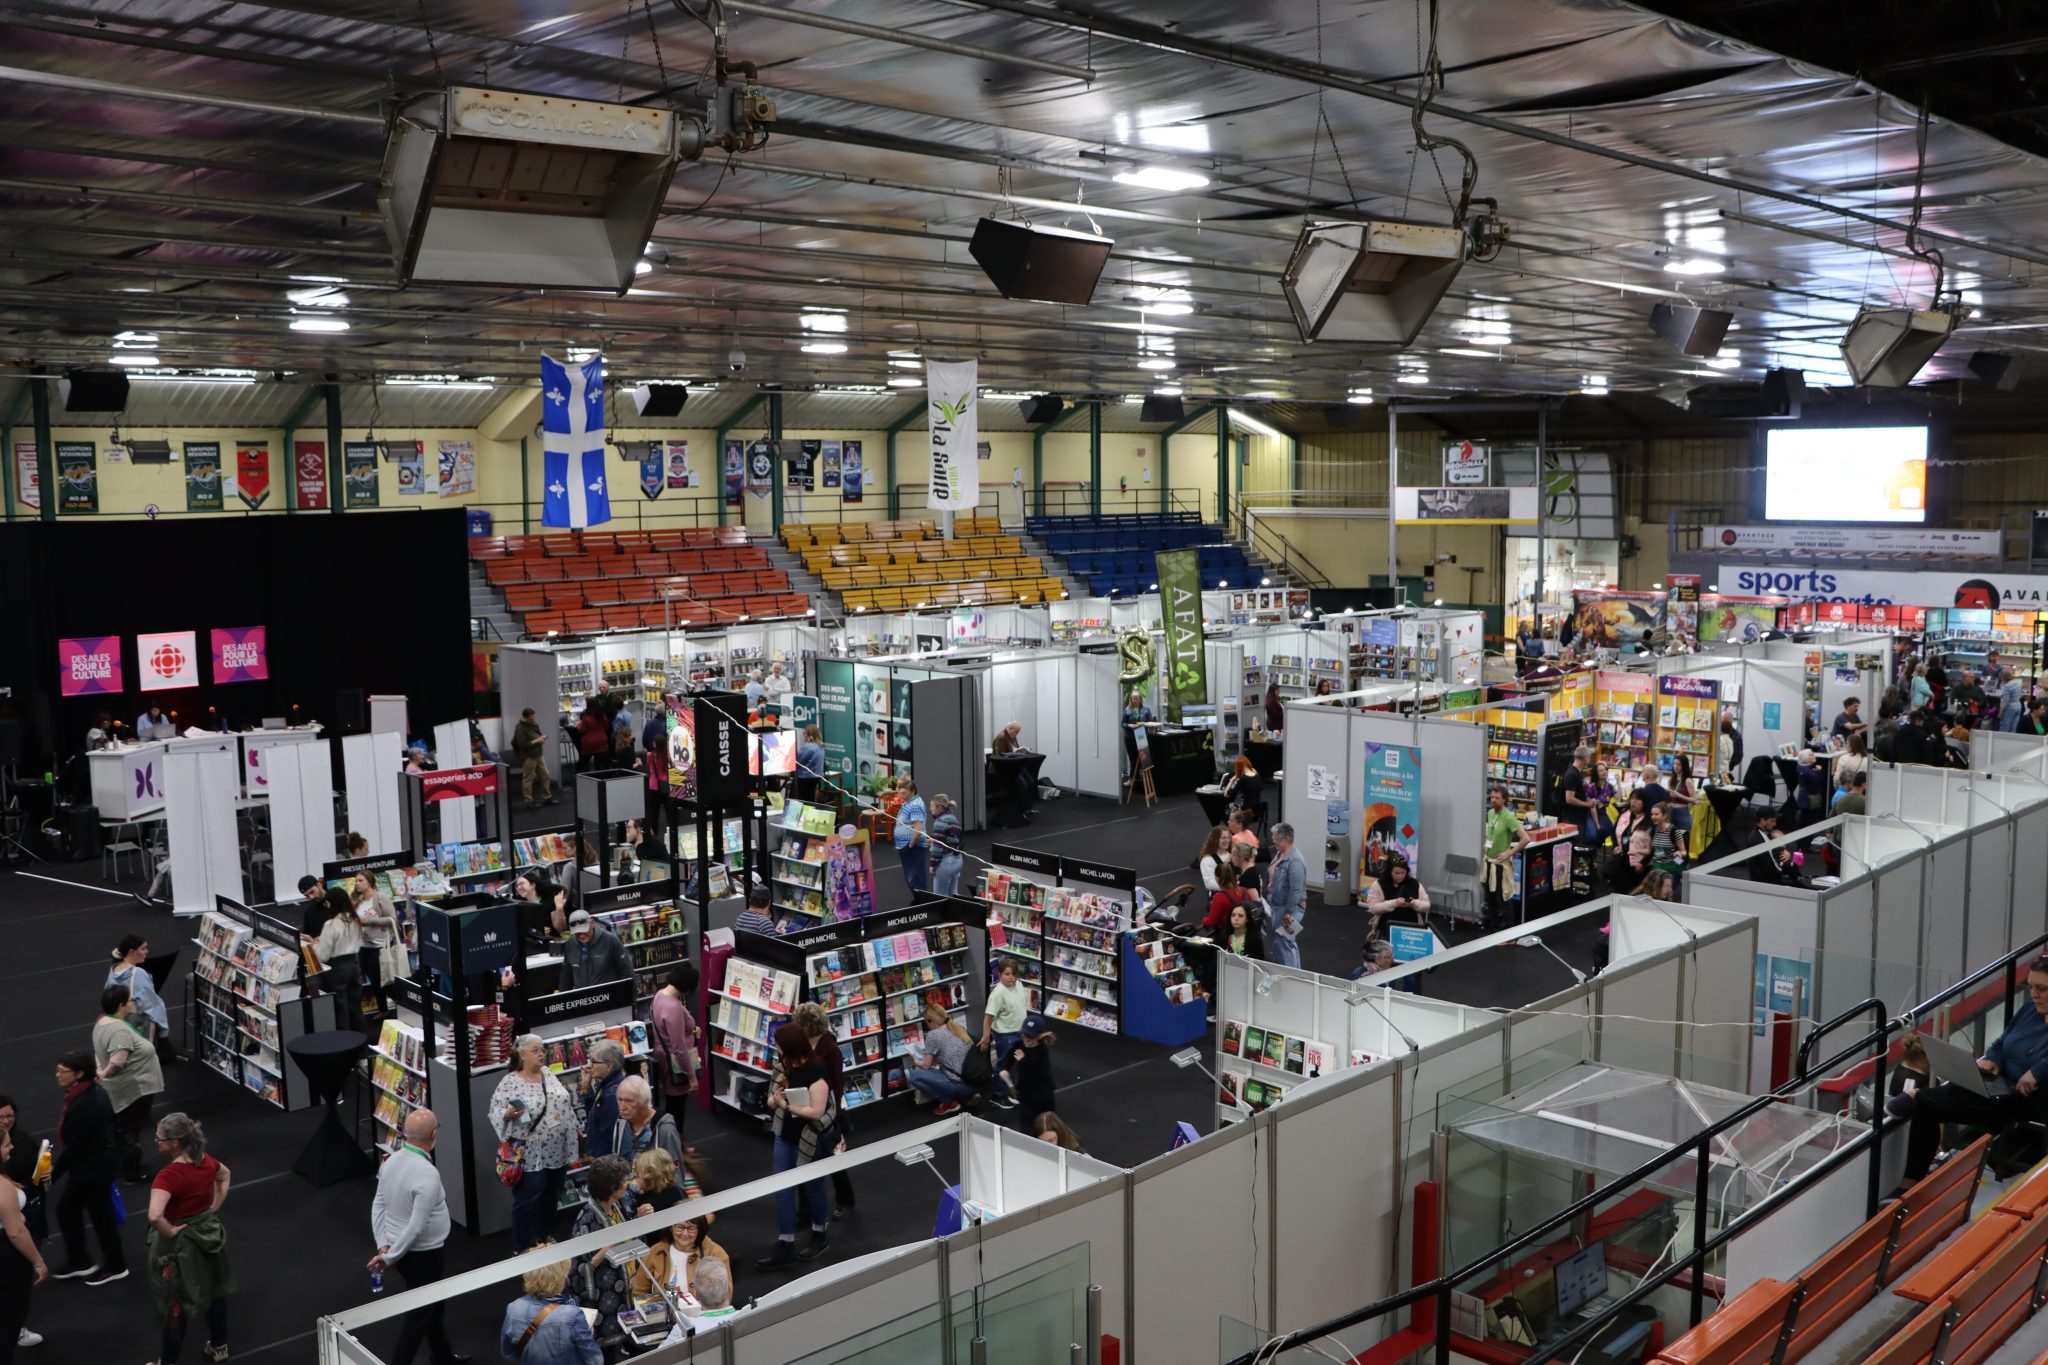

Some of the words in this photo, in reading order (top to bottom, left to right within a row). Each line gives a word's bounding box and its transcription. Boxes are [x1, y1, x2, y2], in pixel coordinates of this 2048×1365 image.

[1738, 569, 1837, 595] sports
[2003, 590, 2048, 600] AVA
[1173, 586, 1198, 662] AFAT
[237, 642, 258, 650] AILES
[71, 655, 87, 664] DES
[88, 653, 111, 662] AILES
[223, 651, 245, 660] POUR
[246, 650, 258, 659] LA
[72, 663, 97, 672] POUR
[98, 662, 111, 671] LA
[223, 658, 259, 669] CULTURE
[72, 670, 112, 680] CULTURE
[719, 720, 730, 776] CAISSE
[424, 773, 467, 785] essageries
[468, 772, 483, 780] adp
[341, 864, 366, 873] PRESSES
[366, 859, 396, 870] AVENTURE
[1023, 857, 1040, 866] MICHEL
[1080, 868, 1098, 877] MICHEL
[1098, 872, 1115, 881] LAFON
[617, 891, 641, 902] WELLAN
[887, 918, 908, 927] MICHEL
[908, 912, 928, 924] LAFON
[798, 938, 816, 947] ALBIN
[816, 932, 838, 945] MICHEL
[545, 1002, 565, 1014] LIBRE
[566, 993, 610, 1010] EXPRESSION
[1308, 1050, 1322, 1067] FILS
